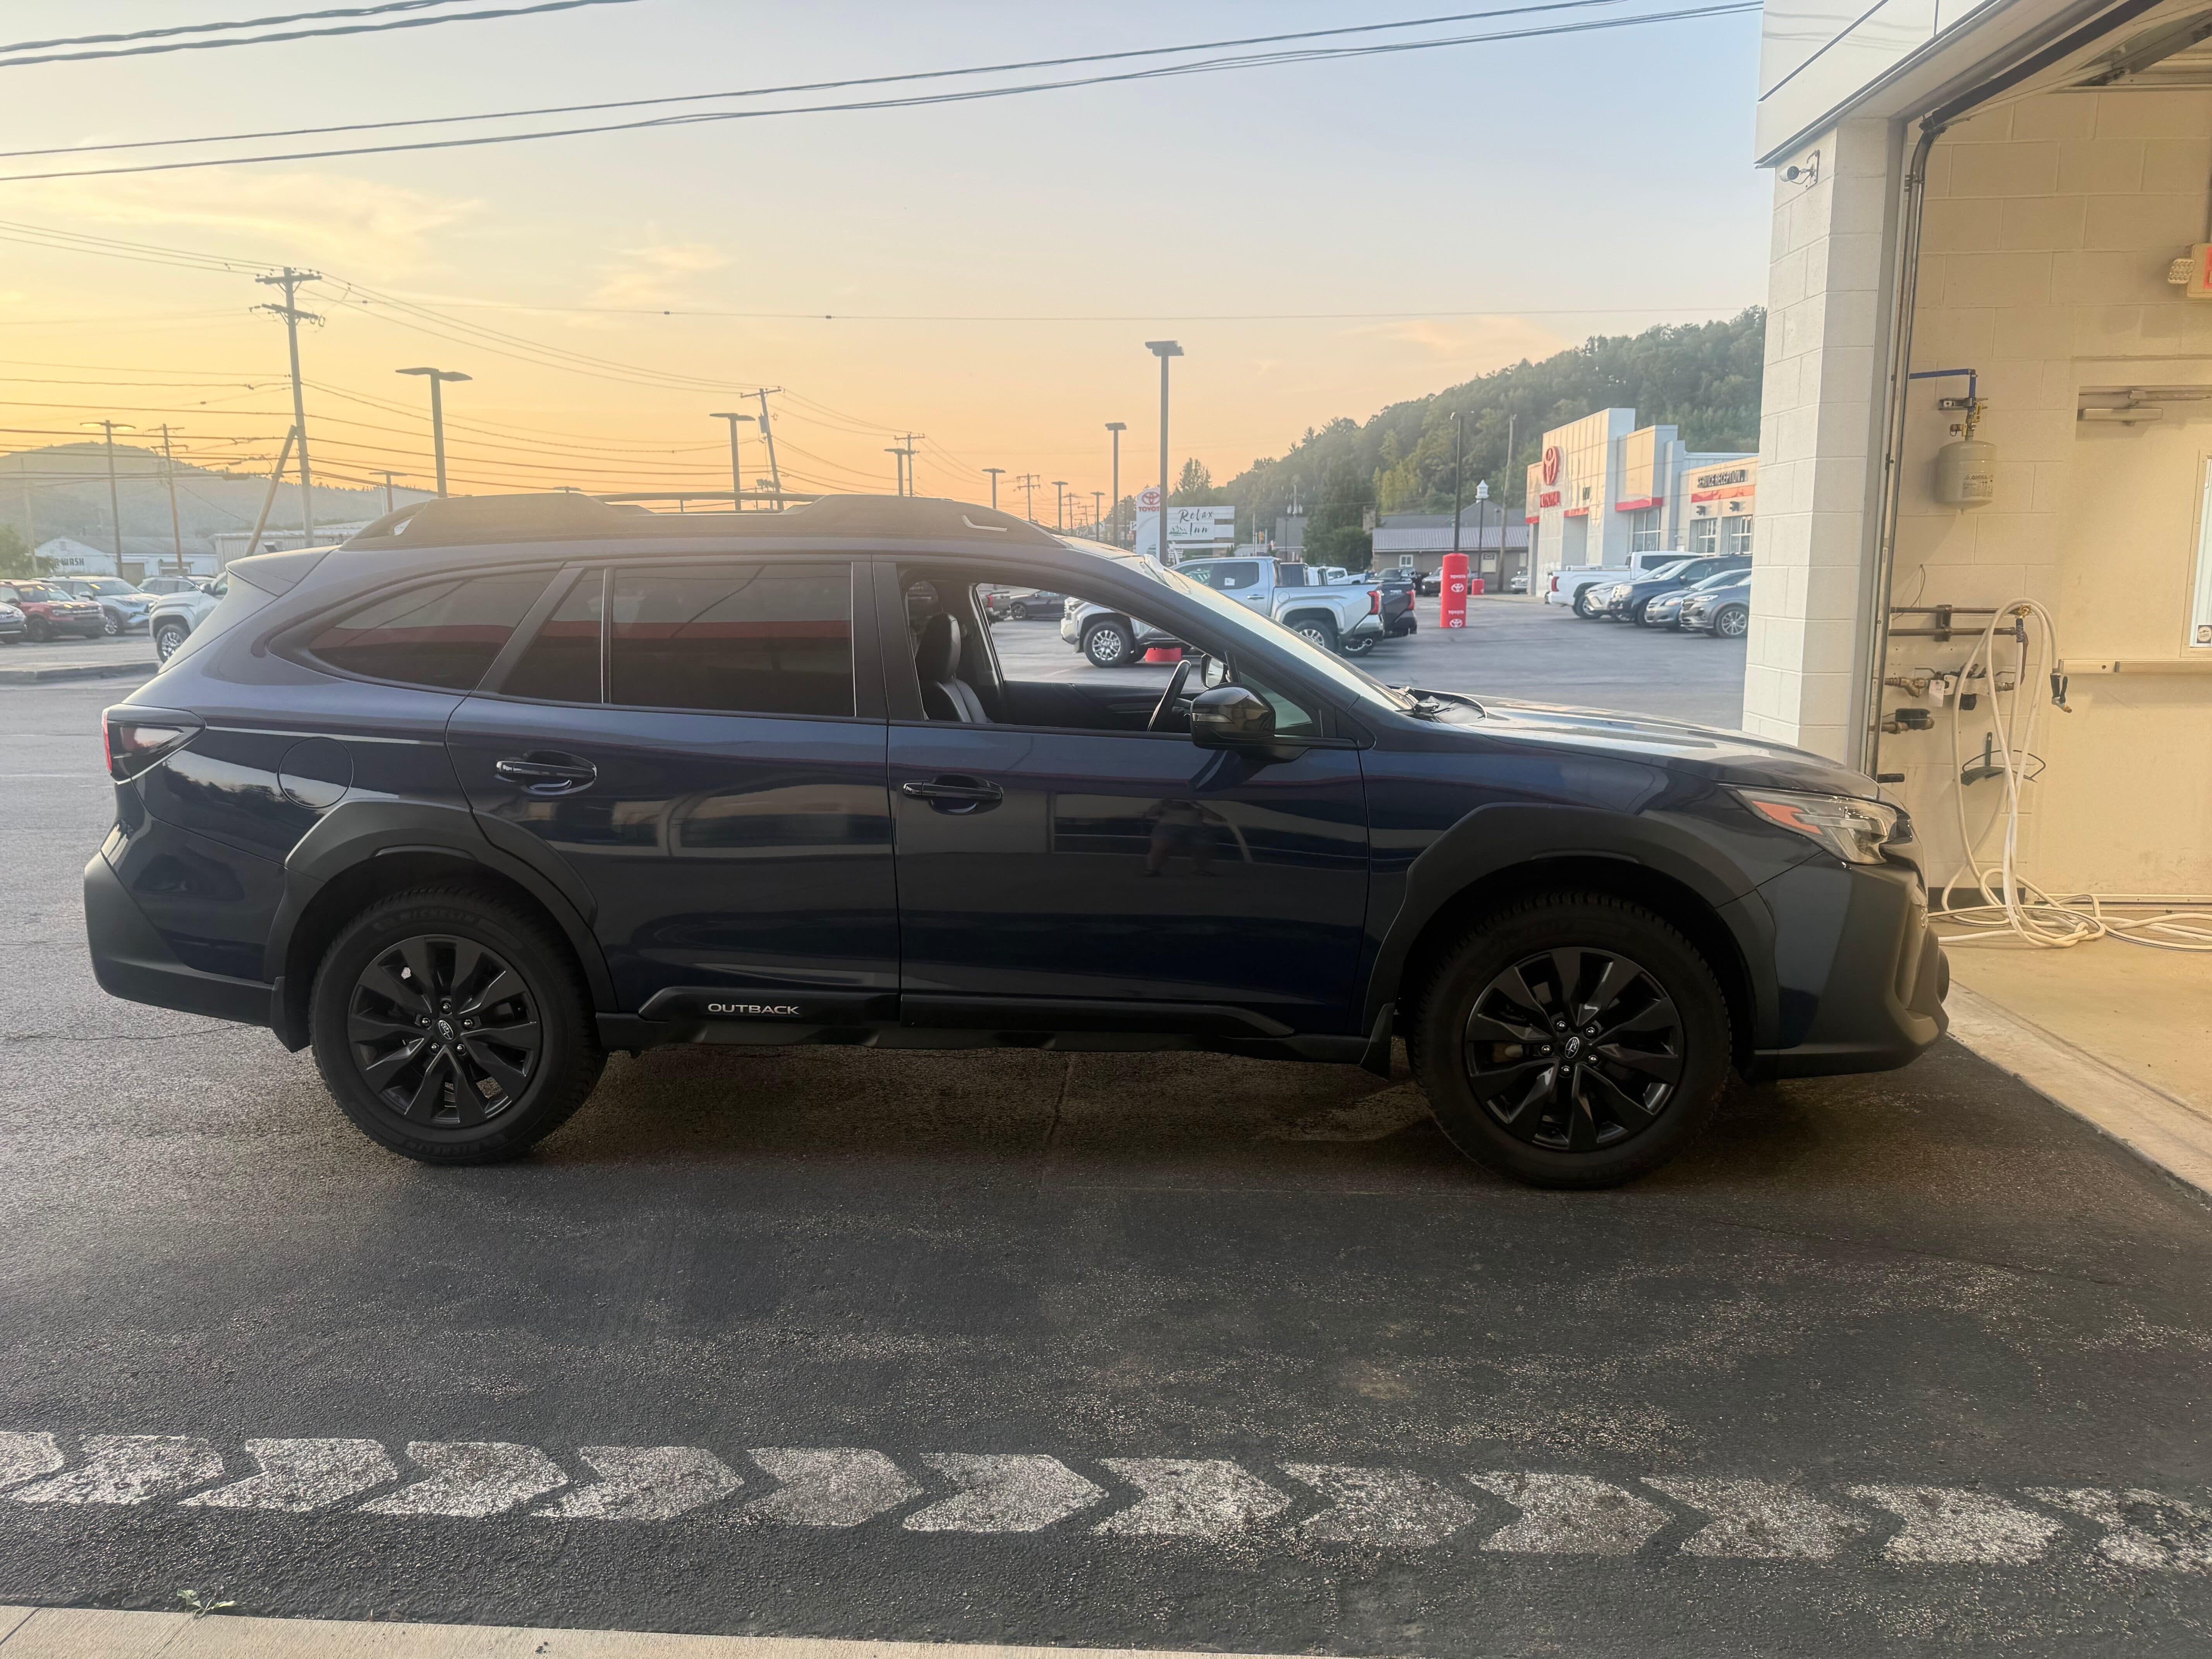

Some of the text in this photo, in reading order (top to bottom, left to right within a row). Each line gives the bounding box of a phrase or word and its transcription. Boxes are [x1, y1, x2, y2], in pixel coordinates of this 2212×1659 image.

[1178, 508, 1213, 524] Relax
[1190, 522, 1207, 536] Inn
[62, 558, 84, 566] WASH
[400, 909, 475, 923] MICHELIN
[708, 1003, 800, 1015] OUTBACK
